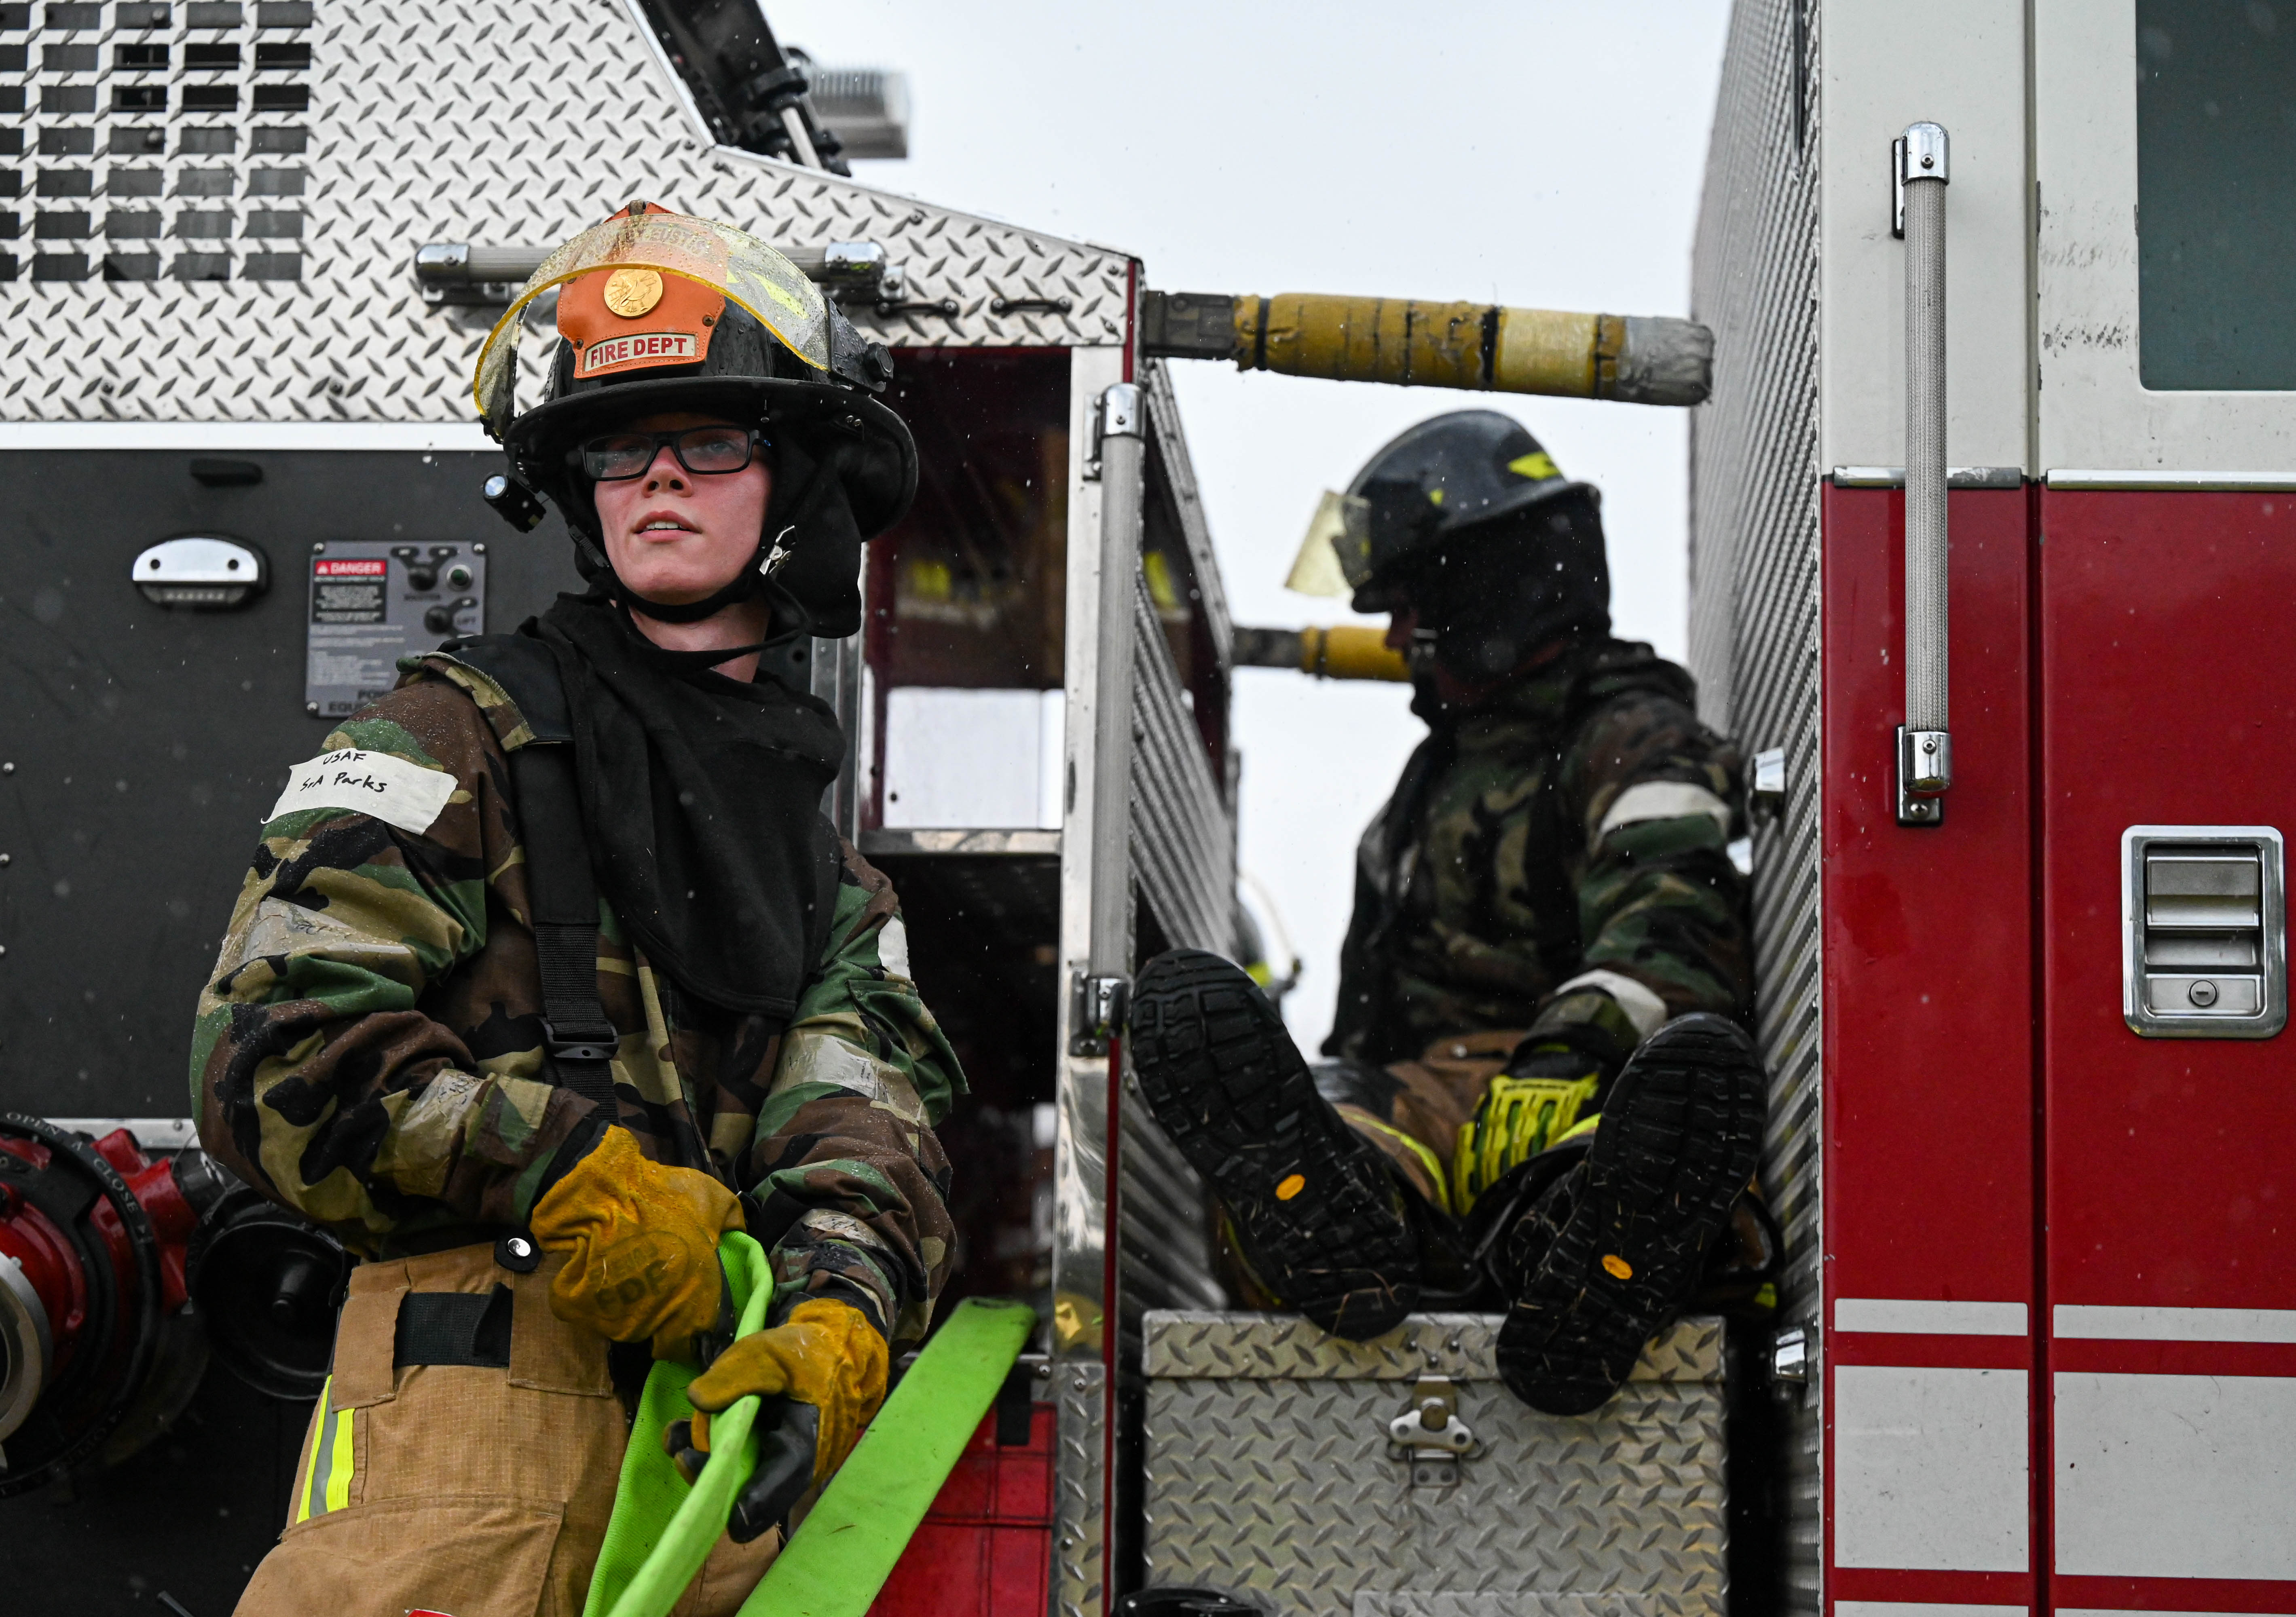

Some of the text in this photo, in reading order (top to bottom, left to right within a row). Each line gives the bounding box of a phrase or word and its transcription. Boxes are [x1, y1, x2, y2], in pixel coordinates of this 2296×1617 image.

[591, 338, 687, 367] FIRE DEPT
[331, 562, 381, 574] DANGER
[323, 752, 367, 765] USAF
[300, 772, 387, 793] SrA Parks
[6, 1112, 59, 1136] OPEN
[93, 1158, 138, 1213] CLOSE
